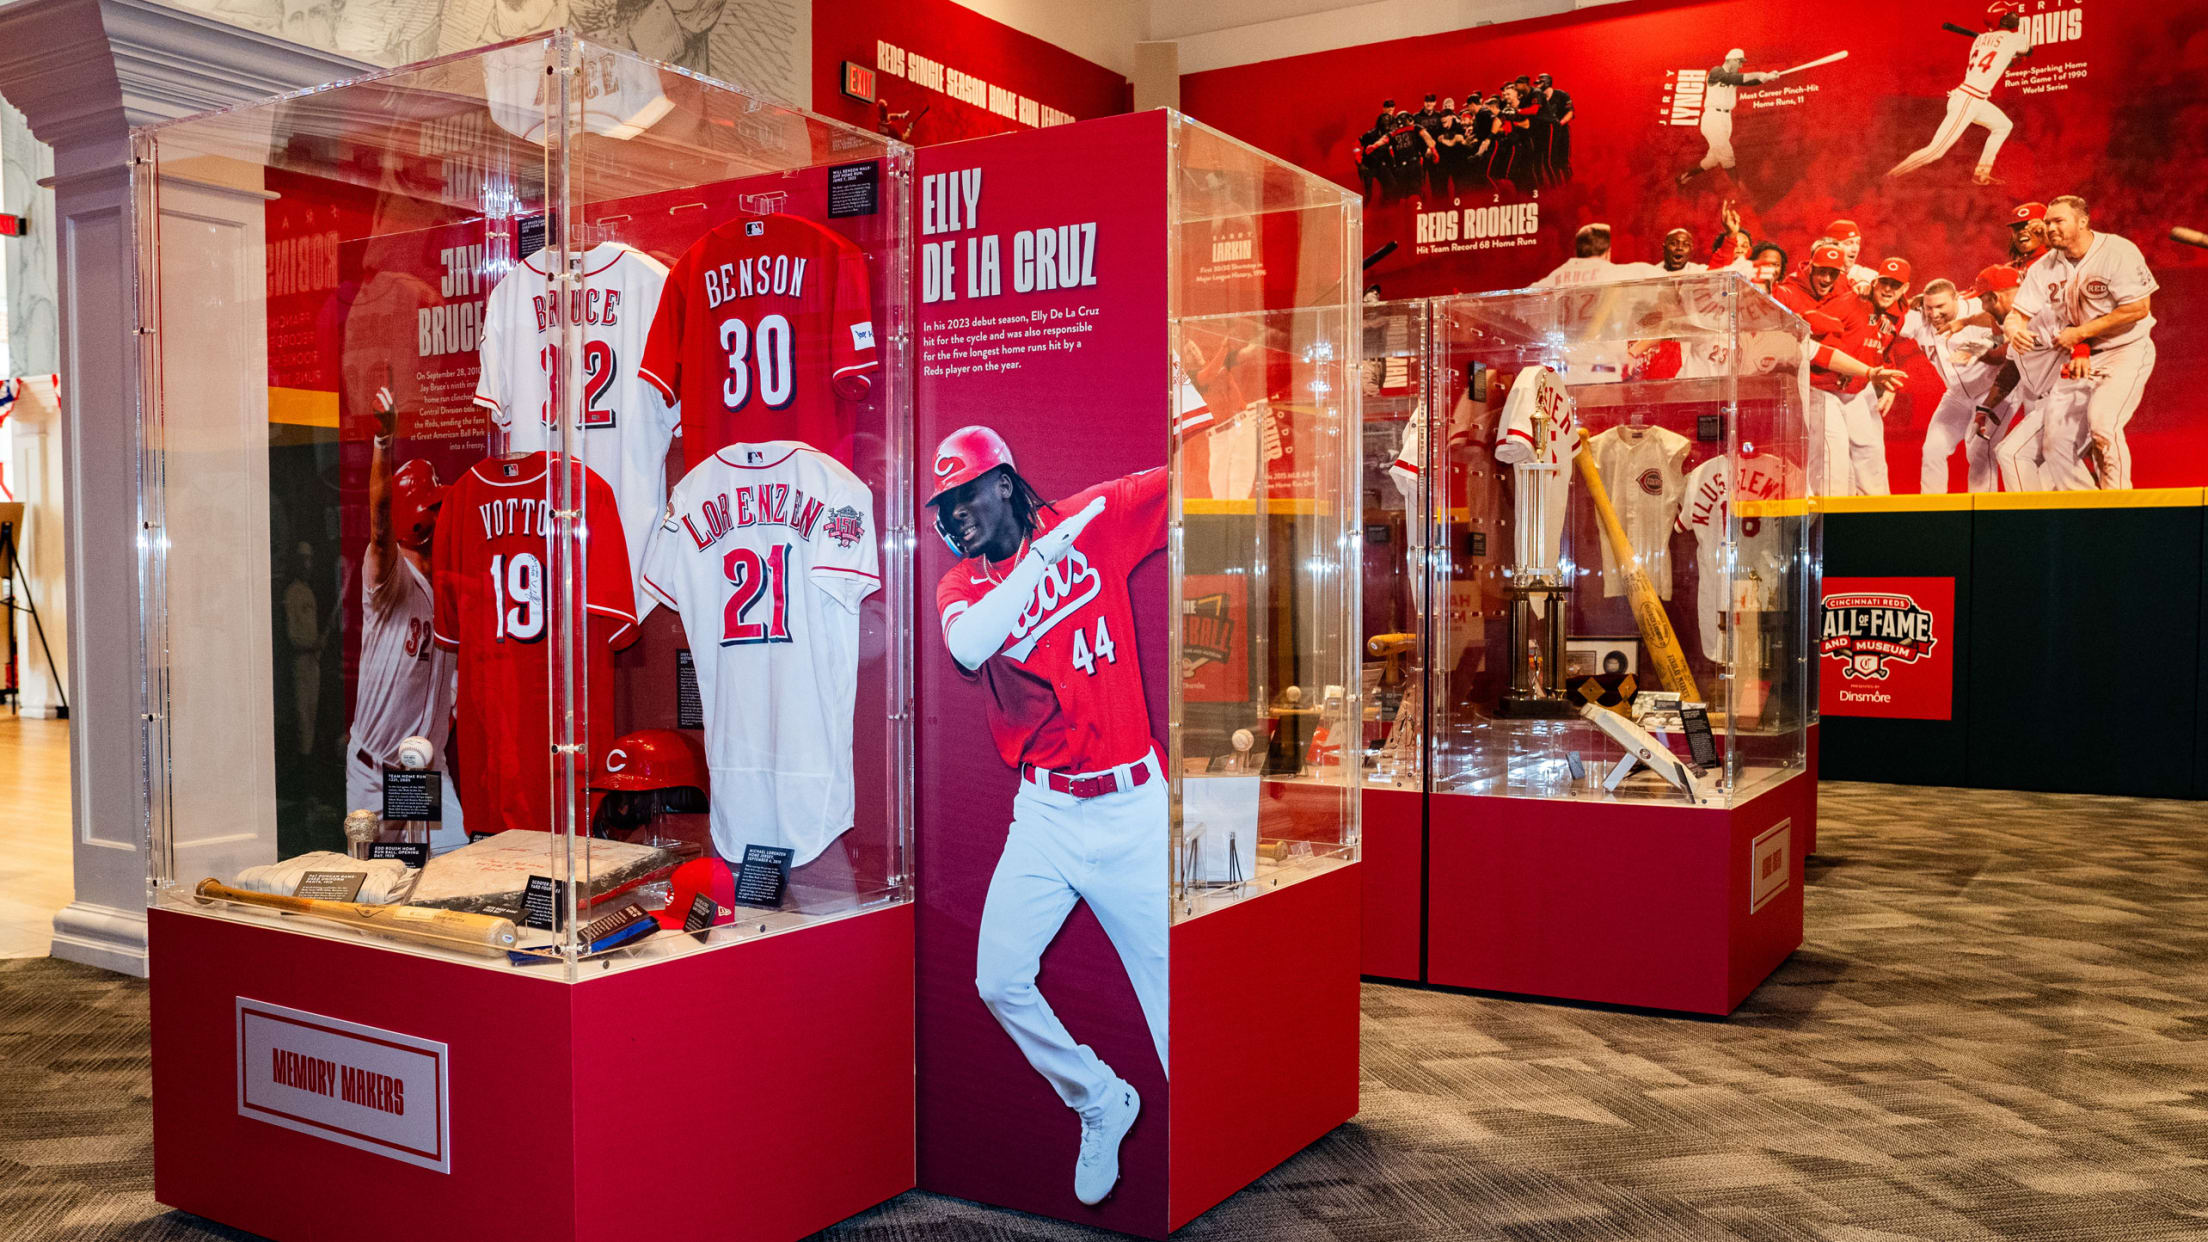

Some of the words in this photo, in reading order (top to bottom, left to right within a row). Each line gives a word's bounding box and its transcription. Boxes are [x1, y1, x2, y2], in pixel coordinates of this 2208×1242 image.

[2018, 8, 2082, 46] DAVIS
[850, 66, 873, 99] EXIT
[877, 40, 905, 79] REDS
[908, 52, 944, 93] SINGLE
[947, 67, 986, 109] SEASON
[989, 84, 1016, 120] HOME
[1019, 96, 1039, 128] RUN
[2005, 65, 2063, 78] Sweep-Sparking
[2065, 61, 2087, 70] Home
[2005, 80, 2019, 88] Run
[2021, 78, 2029, 86] in
[2030, 76, 2052, 86] Game
[2058, 72, 2067, 81] of
[2068, 70, 2087, 79] 1990
[1658, 70, 1675, 126] JERRY
[1670, 69, 1707, 126] LYNCH
[1739, 91, 1757, 100] Most
[1758, 89, 1782, 98] Career
[1784, 84, 1819, 96] Pinch-Hit
[1753, 100, 1774, 109] Home
[1776, 98, 1796, 107] Runs,
[2022, 85, 2045, 95] World
[2046, 83, 2068, 91] Series
[922, 167, 982, 236] ELLY
[1417, 210, 1459, 244] REDS
[1464, 202, 1539, 240] ROOKIES
[922, 240, 956, 304] DE
[967, 234, 1001, 299] LA
[1013, 221, 1097, 293] CRUZ
[1212, 240, 1251, 263] LARKIN
[1417, 246, 1428, 255] Hit
[1430, 245, 1449, 254] Team
[1451, 242, 1477, 252] Record
[1479, 240, 1490, 250] 68
[1492, 238, 1515, 249] Home
[1517, 237, 1537, 246] Runs
[441, 244, 482, 298] JAY
[704, 254, 807, 309] BENSON
[532, 288, 621, 334] BRUCE
[923, 321, 932, 332] In
[933, 320, 946, 331] his
[947, 317, 970, 330] 2023
[972, 316, 996, 327] debut
[998, 314, 1029, 325] season,
[1031, 309, 1048, 325] Elly
[1050, 308, 1064, 319] De
[1065, 307, 1076, 318] La
[1078, 305, 1100, 317] Cruz
[418, 301, 484, 357] BRUCE
[923, 336, 935, 347] hit
[937, 335, 949, 345] for
[951, 333, 965, 344] the
[966, 331, 988, 346] cycle
[989, 329, 1005, 340] and
[1007, 331, 1023, 339] was
[1024, 326, 1041, 337] also
[1043, 321, 1093, 338] responsible
[720, 313, 798, 413] 30
[923, 351, 935, 361] for
[937, 349, 951, 360] the
[953, 348, 968, 359] five
[969, 346, 1000, 360] longest
[1001, 344, 1026, 354] home
[1027, 344, 1047, 352] runs
[1048, 339, 1061, 351] hit
[1063, 338, 1075, 353] by
[1076, 340, 1082, 348] a
[416, 371, 425, 380] On
[426, 370, 455, 382] September
[457, 368, 466, 377] 28,
[923, 365, 944, 376] Reds
[945, 363, 970, 379] player
[972, 365, 983, 373] on
[985, 360, 999, 371] the
[1001, 362, 1022, 374] year.
[420, 384, 429, 393] Jay
[430, 382, 449, 392] Bruce's
[451, 381, 466, 390] ninth
[424, 395, 439, 404] home
[451, 394, 474, 402] clinched
[414, 420, 424, 429] the
[425, 419, 439, 429] Reds,
[440, 418, 461, 429] sending
[463, 417, 472, 425] the
[473, 416, 485, 425] fans
[419, 407, 440, 416] Central
[440, 406, 463, 415] Division
[463, 405, 475, 413] title
[417, 432, 432, 441] Great
[433, 430, 459, 439] American
[460, 429, 471, 437] Ball
[472, 428, 485, 437] Park
[449, 442, 461, 450] into
[466, 441, 486, 451] frenzy.
[479, 498, 548, 540] VOTTO
[681, 483, 825, 553] LORENZEN
[490, 552, 548, 644] 19
[720, 542, 794, 648] 21
[1012, 545, 1101, 639] eds
[1829, 598, 1880, 607] CINCINNATI
[1882, 598, 1905, 607] REDS
[405, 617, 431, 662] 32
[1822, 609, 1863, 637] ALL
[1858, 614, 1869, 626] OF
[1870, 609, 1929, 642] FAME
[1072, 615, 1116, 676] 44
[1824, 637, 1849, 650] AND
[1856, 642, 1910, 657] MUSEUM
[606, 748, 627, 773] C
[272, 1047, 336, 1098] MEMORY
[341, 1064, 405, 1116] MAKERS
